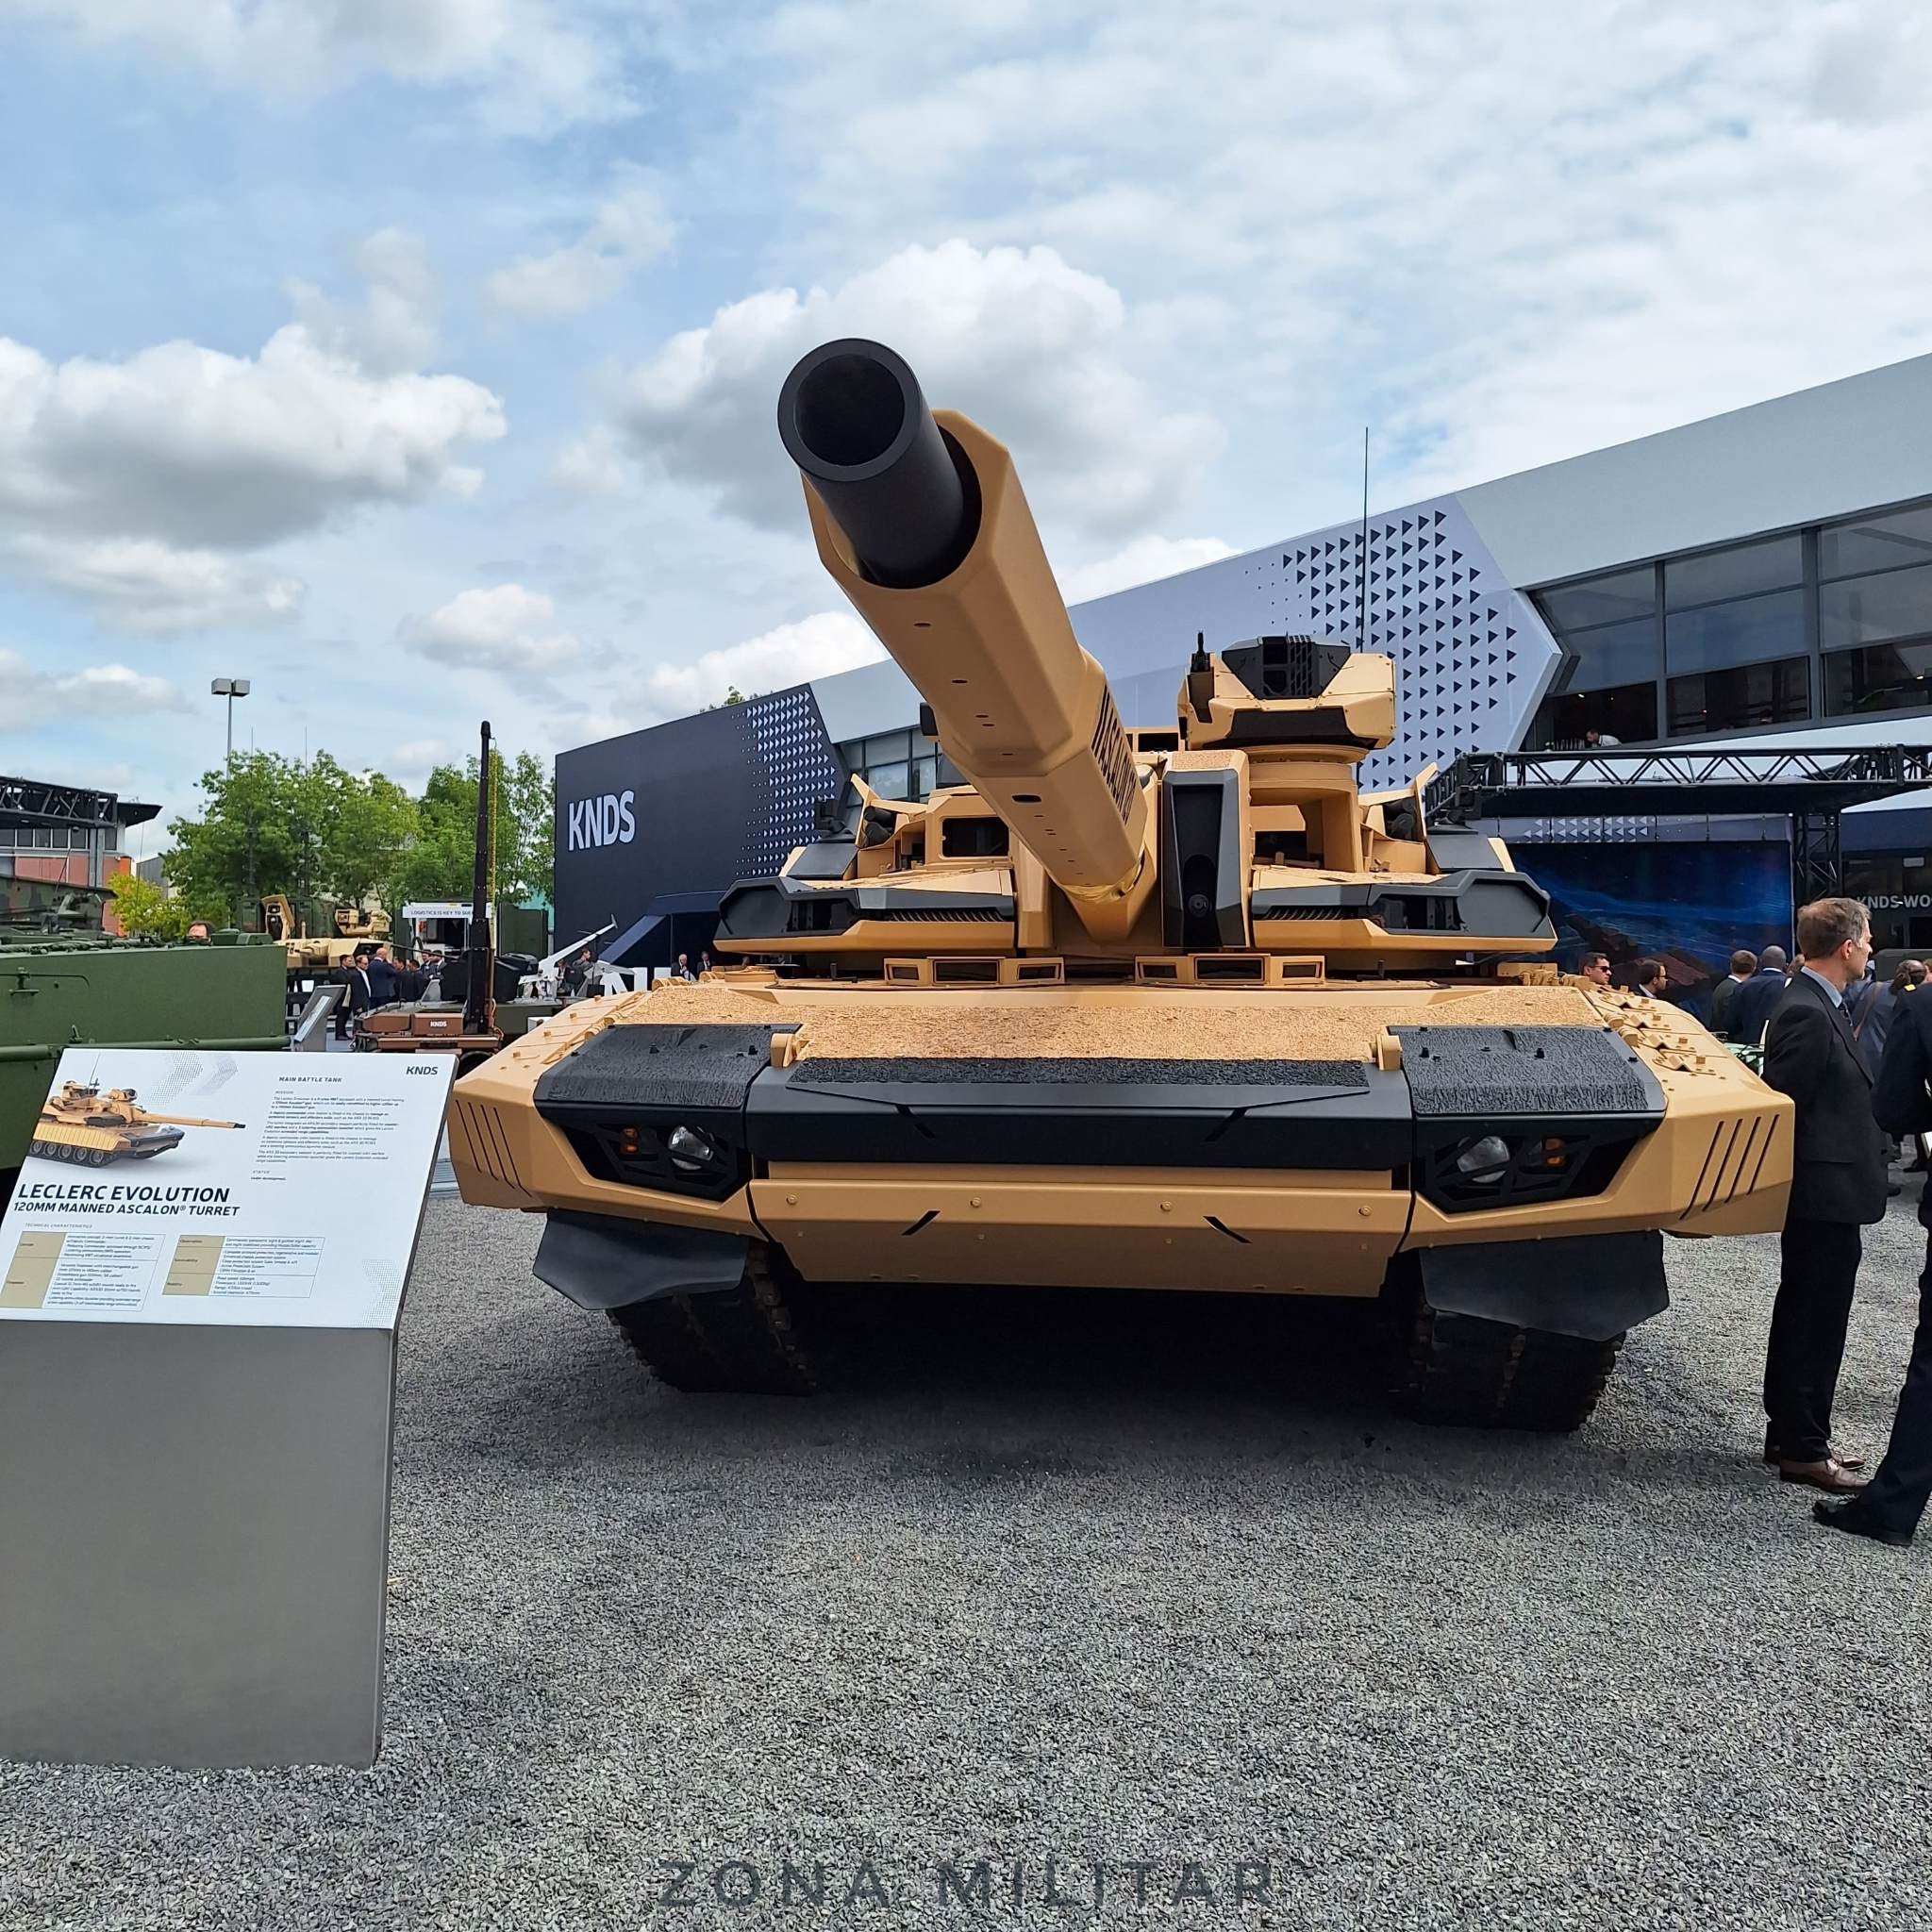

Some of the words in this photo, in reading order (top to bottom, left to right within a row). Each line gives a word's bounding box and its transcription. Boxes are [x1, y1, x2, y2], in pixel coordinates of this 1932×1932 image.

[569, 790, 635, 851] KNDS
[1904, 894, 1932, 908] WO
[406, 1066, 439, 1075] KNDS
[18, 1184, 108, 1200] LECLERC
[110, 1186, 230, 1203] EVOLUTION
[14, 1202, 57, 1212] 120MM
[58, 1203, 114, 1214] MANNED
[189, 1206, 240, 1216] TURRET
